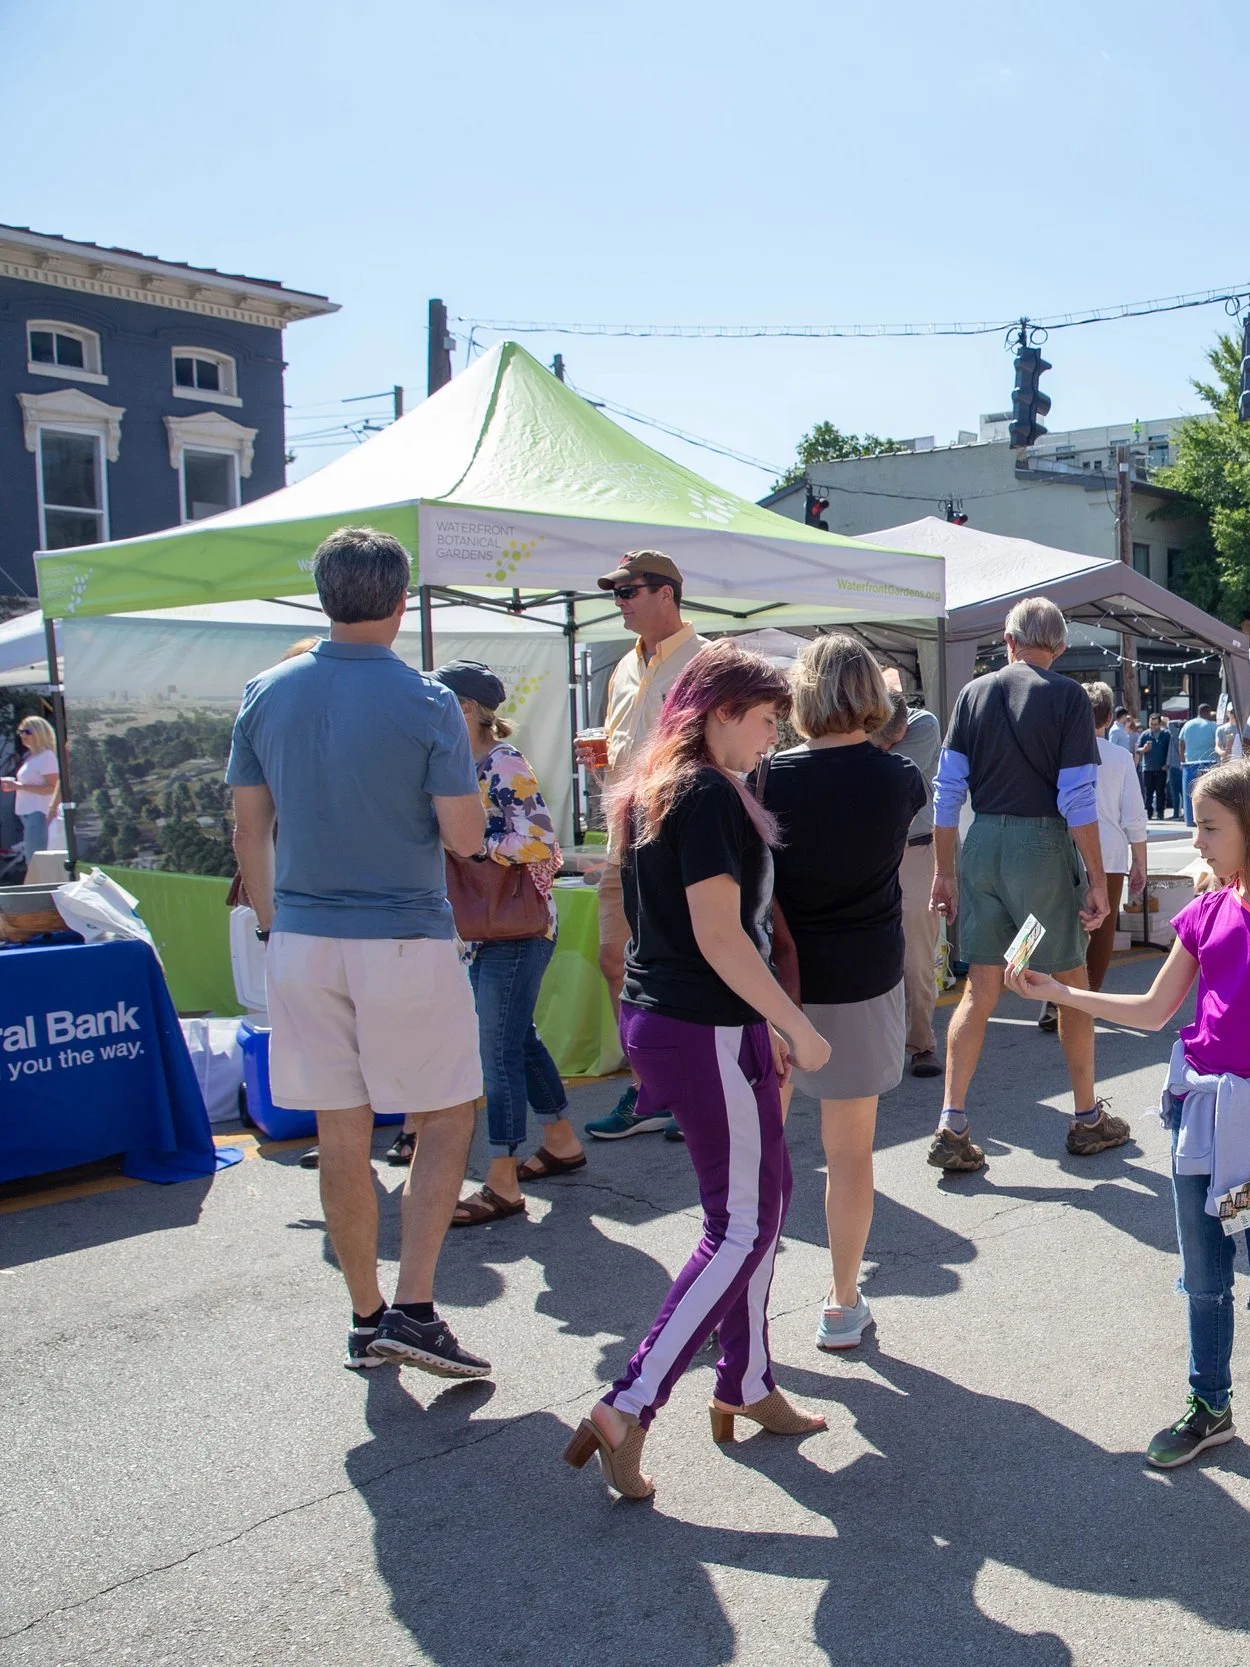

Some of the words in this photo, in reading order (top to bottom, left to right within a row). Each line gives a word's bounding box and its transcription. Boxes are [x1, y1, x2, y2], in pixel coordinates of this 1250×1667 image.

[436, 521, 515, 536] WATERFRONT
[437, 535, 501, 549] BOTANICAL
[436, 548, 494, 561] GARDENS
[837, 578, 941, 601] WaterfrontGardens.org
[46, 1001, 141, 1045] Bank
[8, 1057, 53, 1081] you
[58, 1049, 95, 1068] the
[100, 1041, 145, 1060] way.
